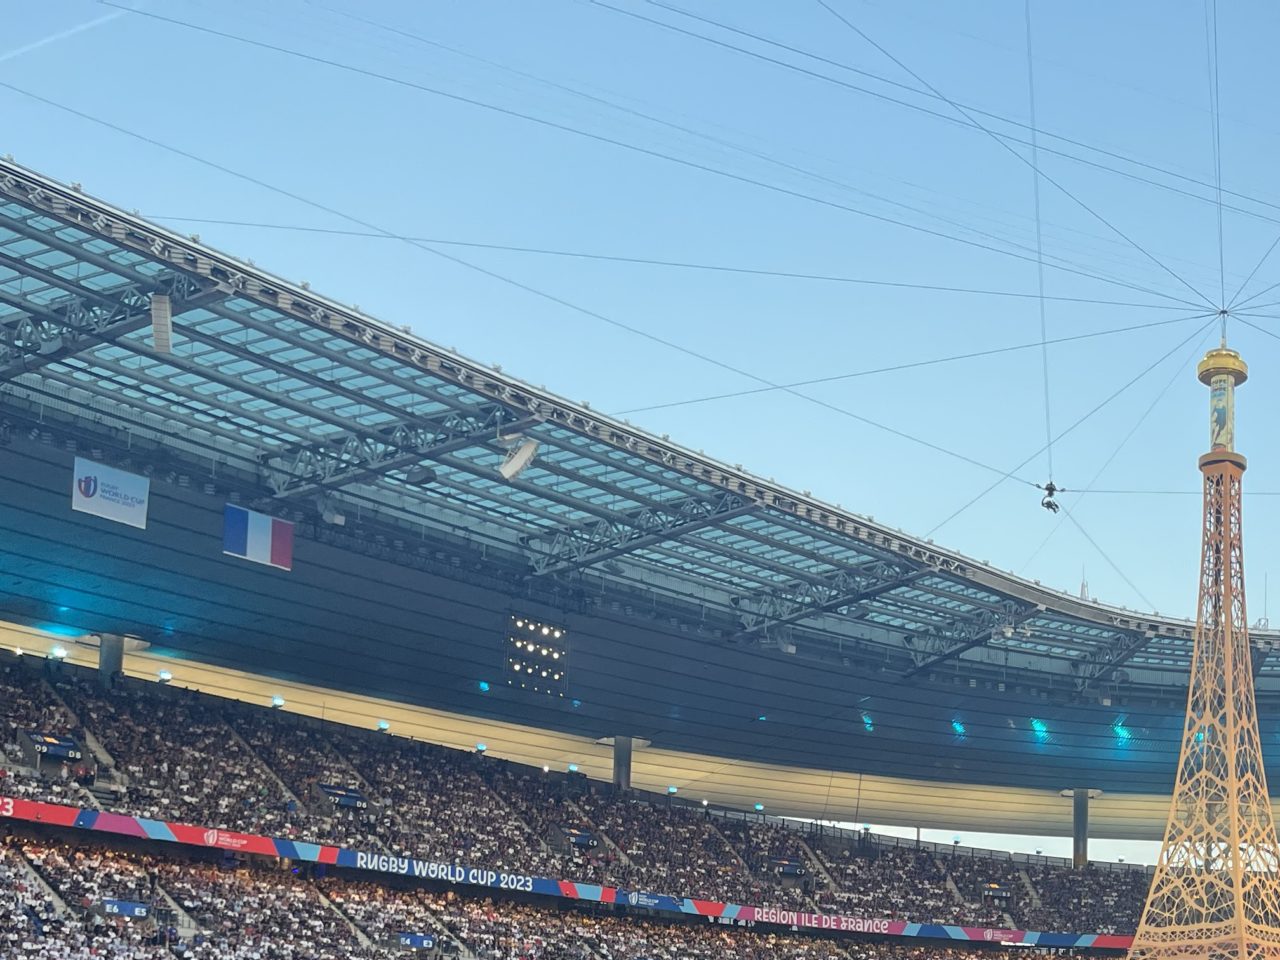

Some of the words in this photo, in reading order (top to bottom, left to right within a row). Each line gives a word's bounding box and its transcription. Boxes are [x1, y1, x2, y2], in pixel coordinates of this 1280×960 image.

[357, 852, 408, 874] RUGBY
[413, 860, 465, 882] WORLD
[468, 869, 497, 887] CUP
[499, 874, 533, 892] 2023
[105, 903, 119, 913] E6
[134, 906, 147, 917] E5
[822, 915, 837, 929] DE
[840, 917, 889, 933] FRANCE
